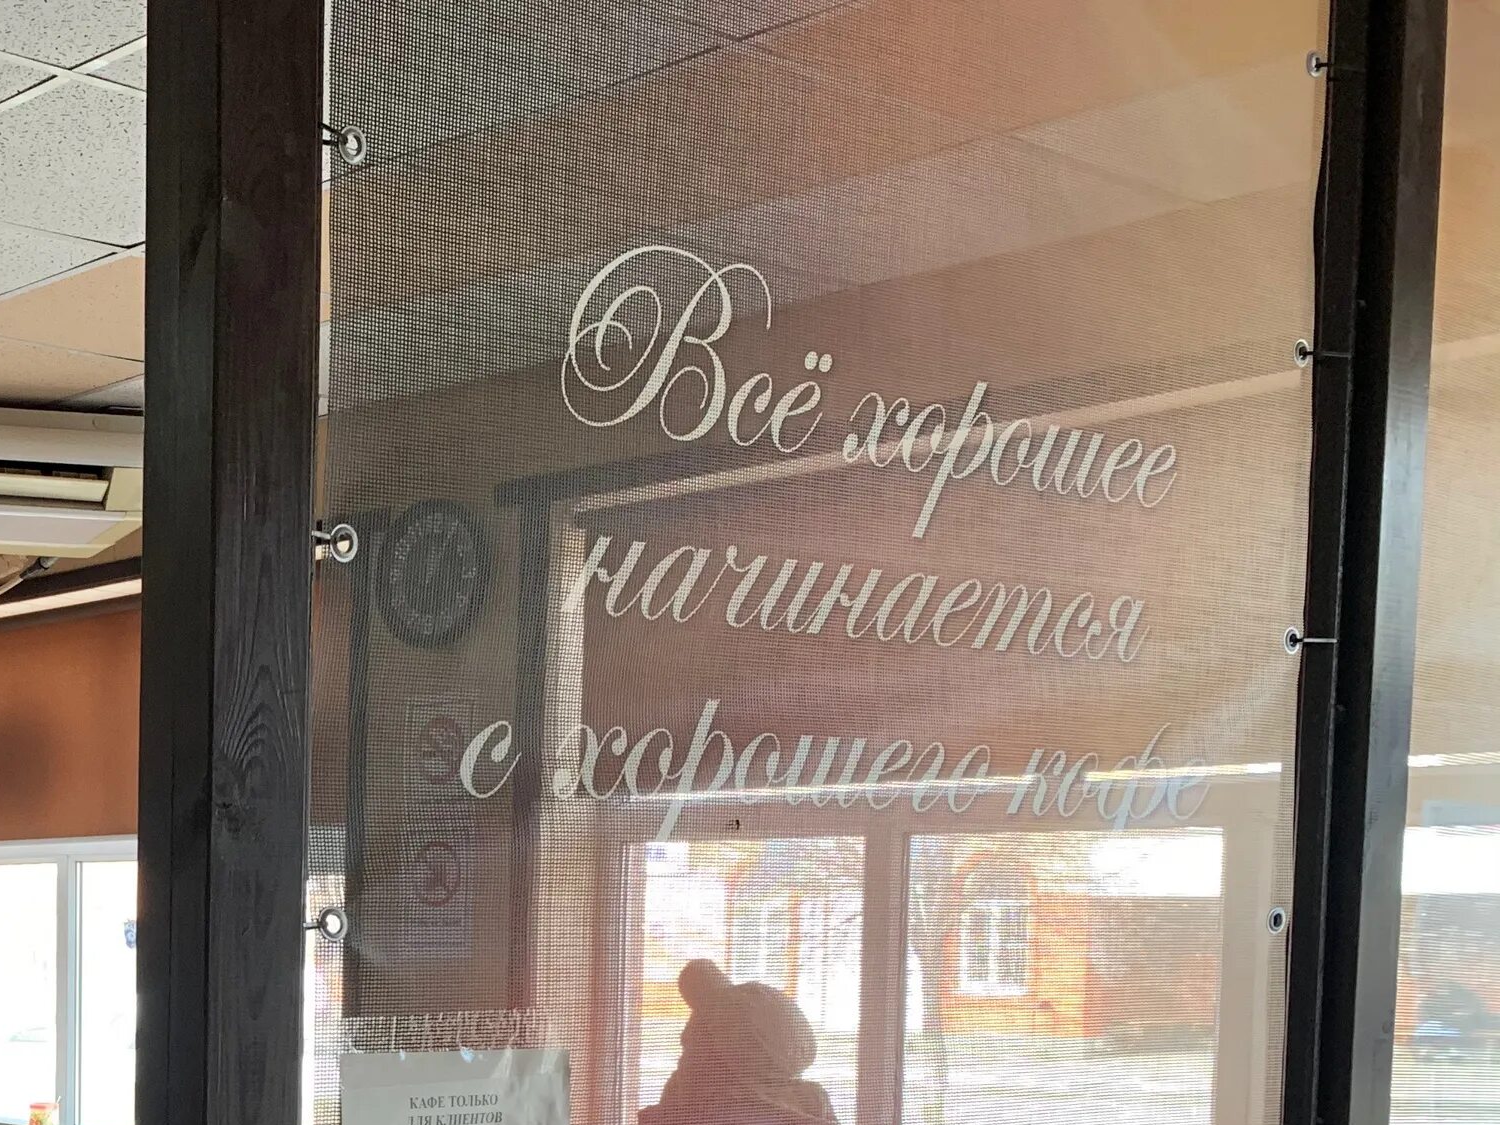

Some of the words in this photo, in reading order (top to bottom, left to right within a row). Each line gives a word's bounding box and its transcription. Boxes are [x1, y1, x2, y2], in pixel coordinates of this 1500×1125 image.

[561, 246, 833, 453] Всё
[841, 380, 1178, 539] хорошее
[578, 535, 1151, 664] начинается
[458, 719, 522, 798] с
[552, 697, 991, 842] хорошего
[1006, 722, 1211, 831] кофе
[410, 1096, 445, 1110] КАФЕ
[449, 1094, 499, 1108] ТОЛЬКО
